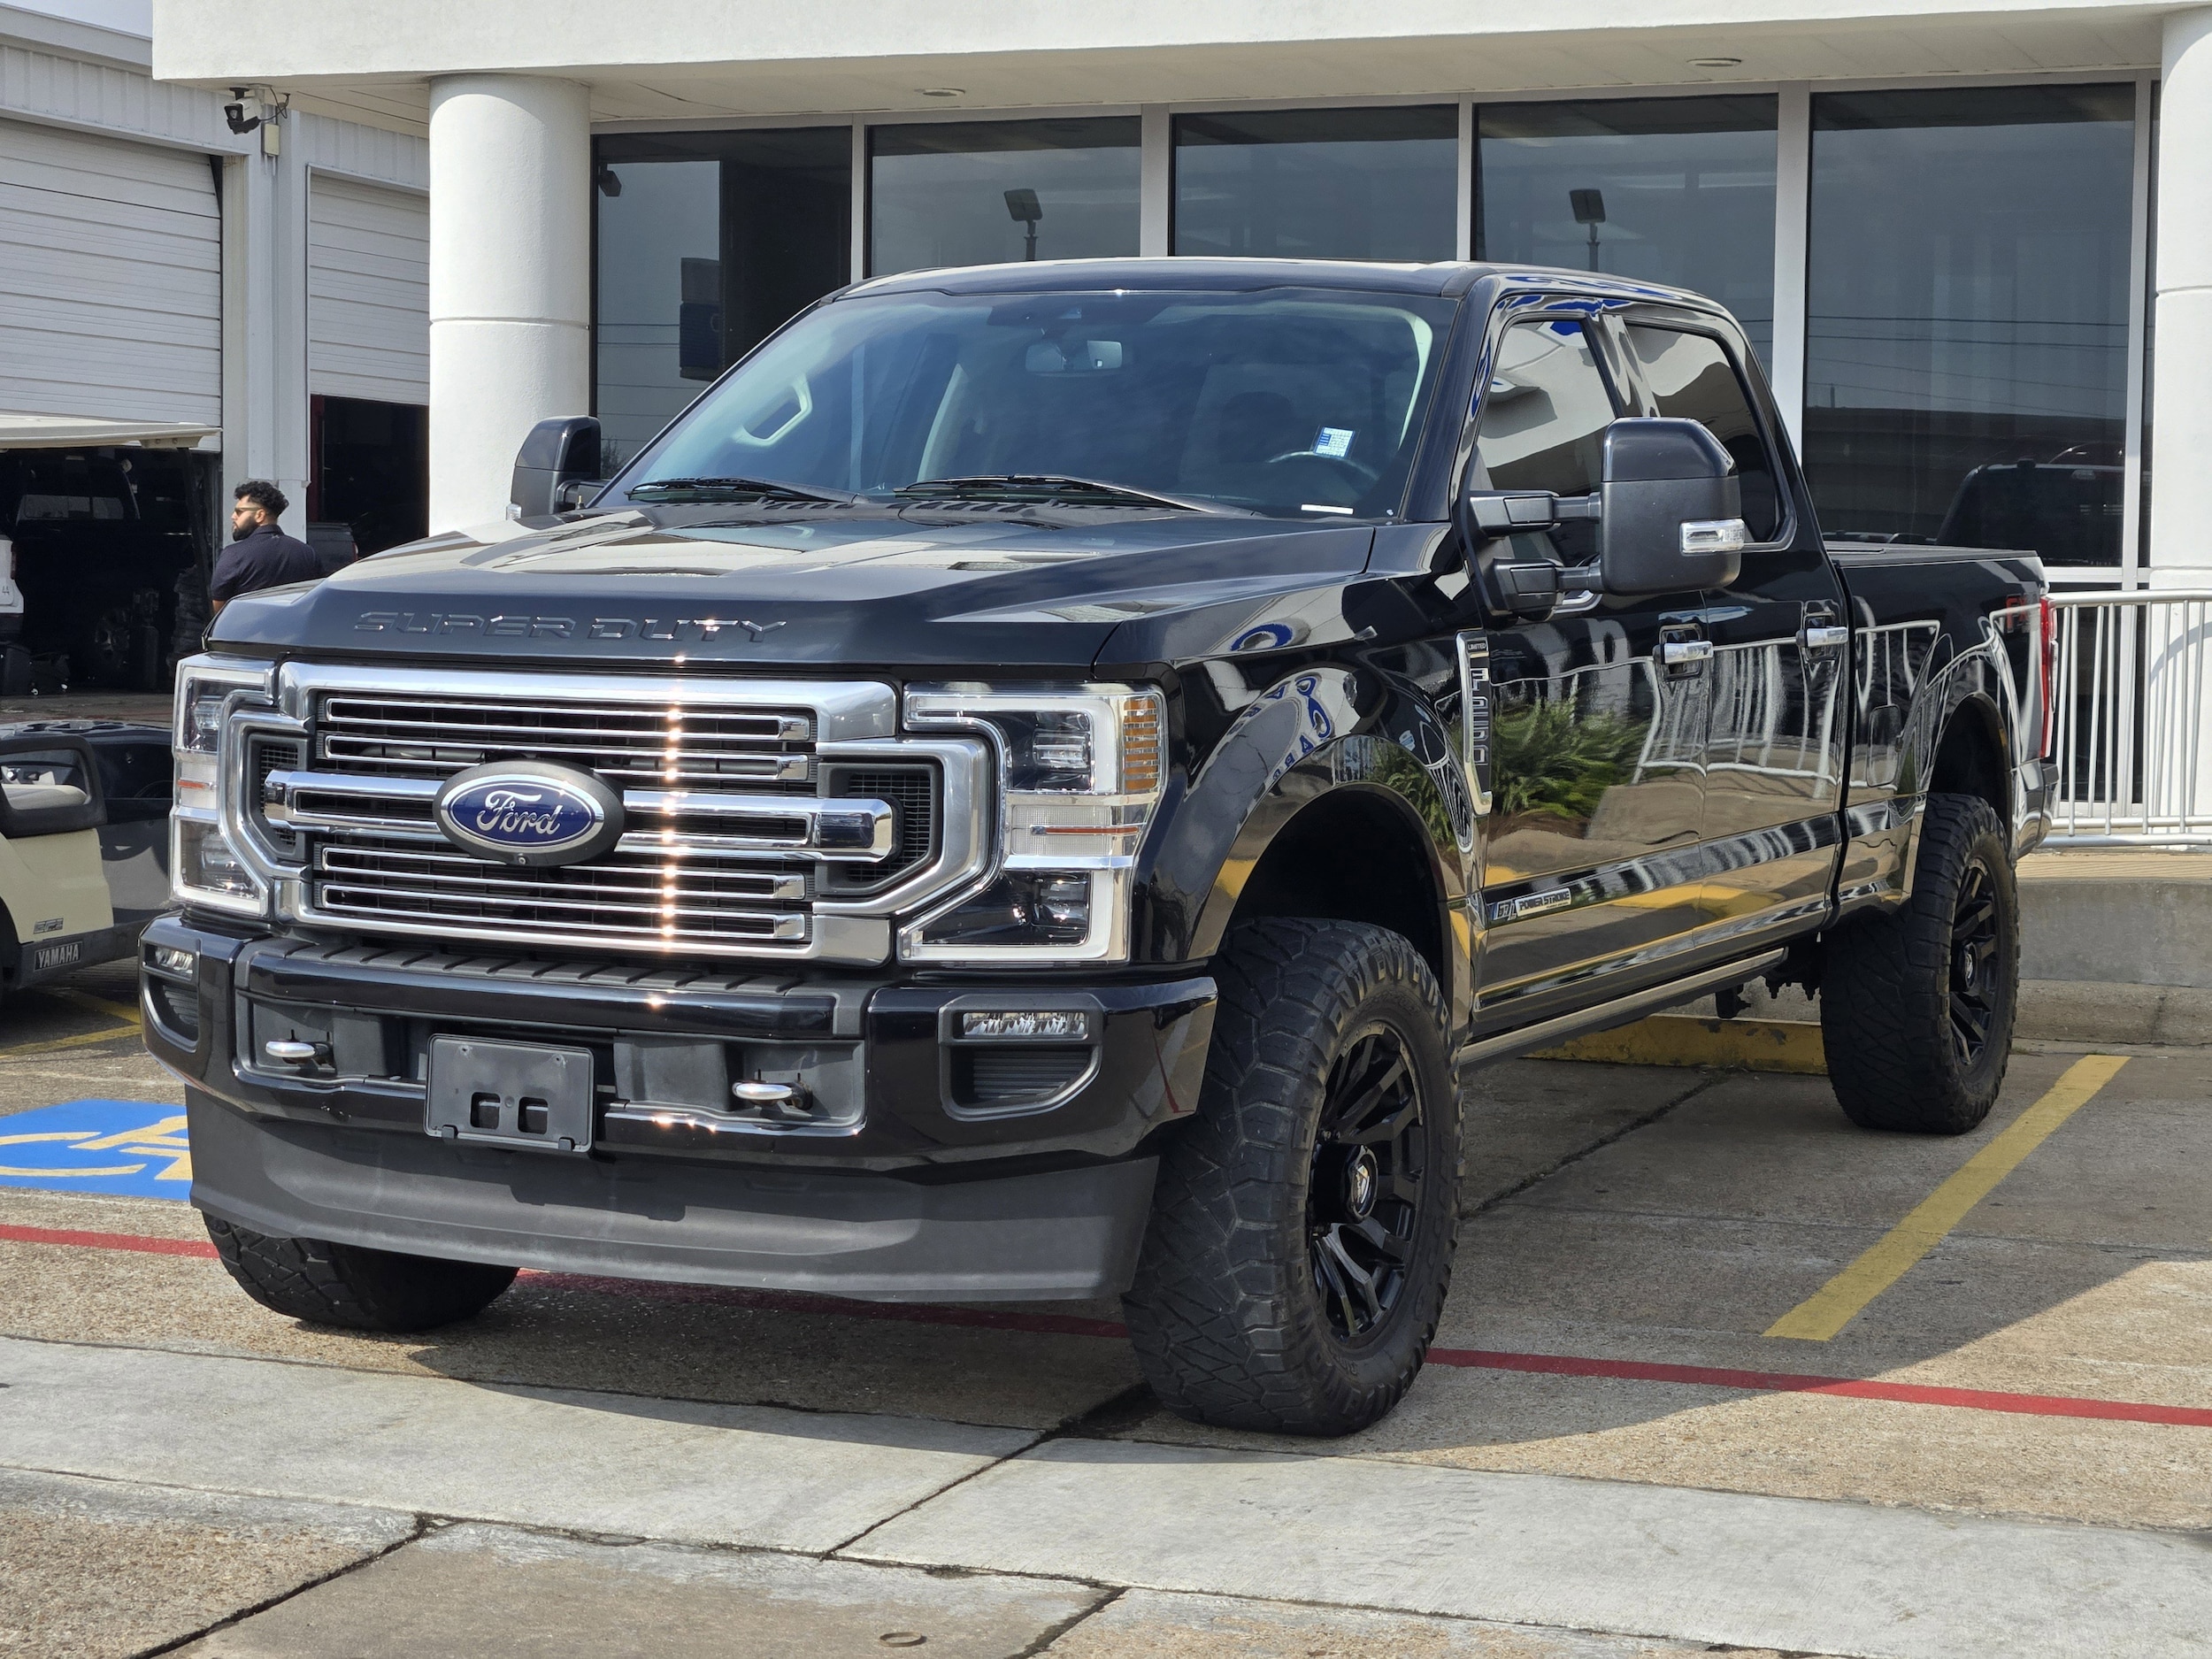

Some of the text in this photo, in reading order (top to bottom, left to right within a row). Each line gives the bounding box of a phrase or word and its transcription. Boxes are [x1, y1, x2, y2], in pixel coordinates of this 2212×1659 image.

[353, 611, 787, 643] SUPER DUTY
[476, 790, 564, 835] Ford
[1519, 896, 1543, 911] POWER
[1544, 890, 1570, 905] STROKE
[38, 943, 79, 969] YAMAHA
